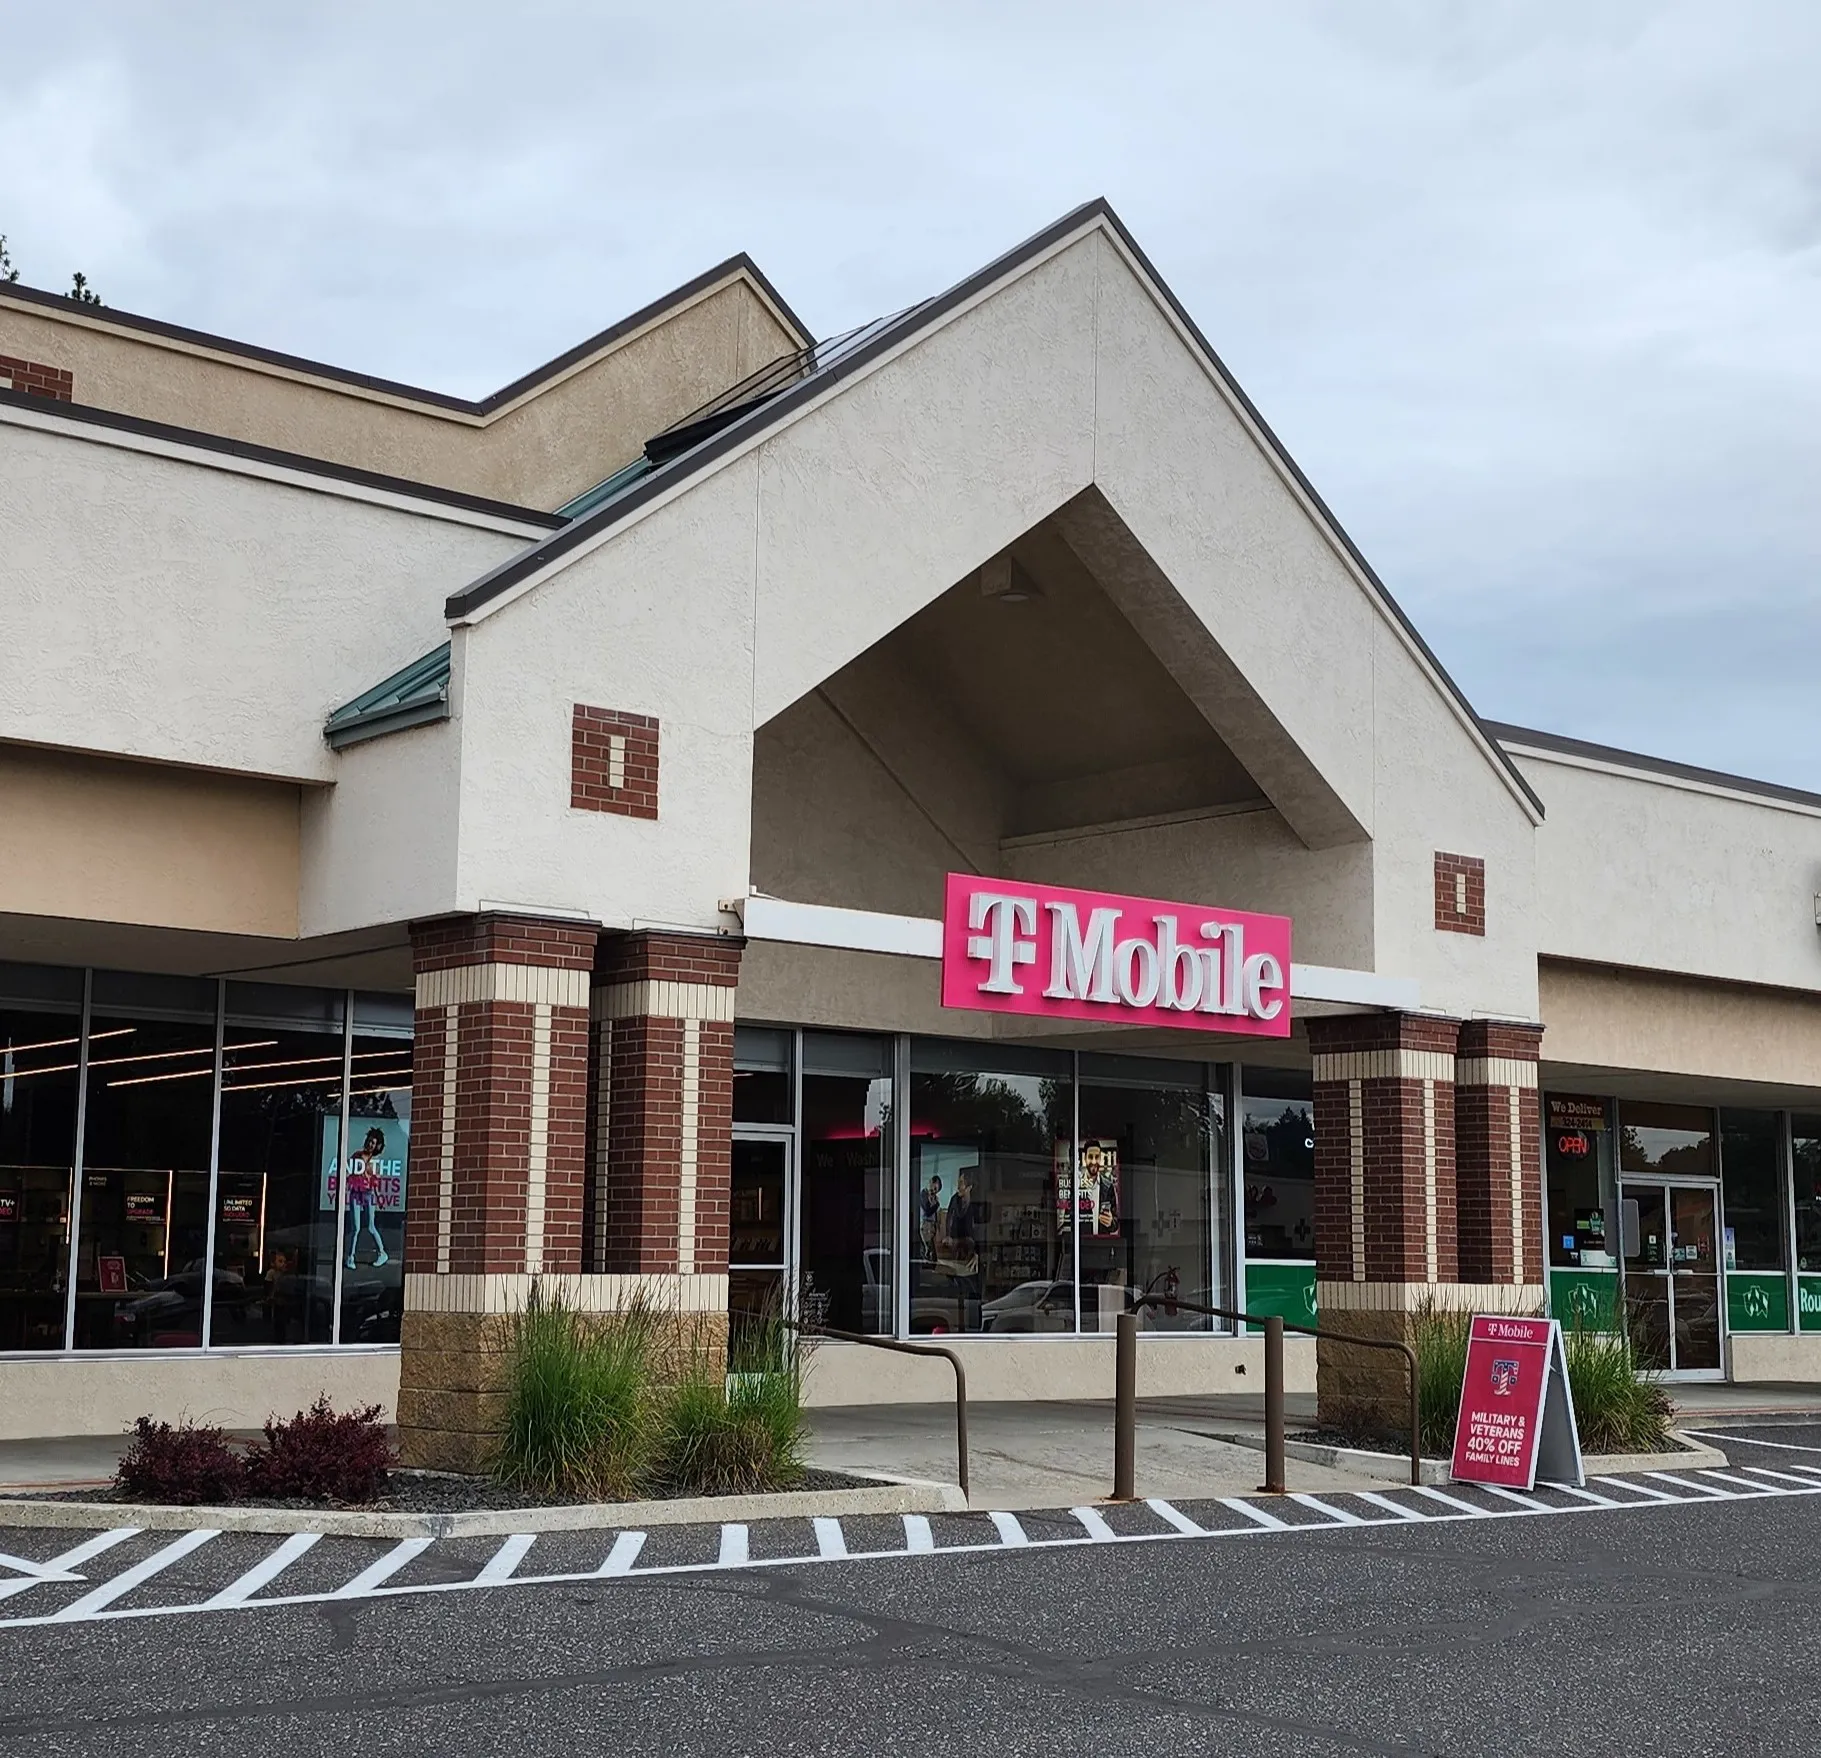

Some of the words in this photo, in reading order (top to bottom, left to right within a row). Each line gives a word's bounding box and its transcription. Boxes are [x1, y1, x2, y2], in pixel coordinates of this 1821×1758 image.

[1042, 902, 1284, 1020] Mobile
[1551, 1100, 1566, 1113] We
[1568, 1102, 1602, 1115] Deliver
[1559, 1136, 1589, 1153] OPEN
[370, 1160, 401, 1176] THE
[371, 1195, 399, 1208] LOVE
[1498, 1323, 1533, 1339] Mobile
[1471, 1411, 1517, 1426] MILITARY
[1518, 1416, 1525, 1427] &
[1470, 1423, 1525, 1440] VETERANS
[1467, 1436, 1495, 1452] 40%
[1498, 1440, 1522, 1455] OFF
[1465, 1451, 1495, 1463] FAMILY
[1495, 1455, 1520, 1467] LINES
